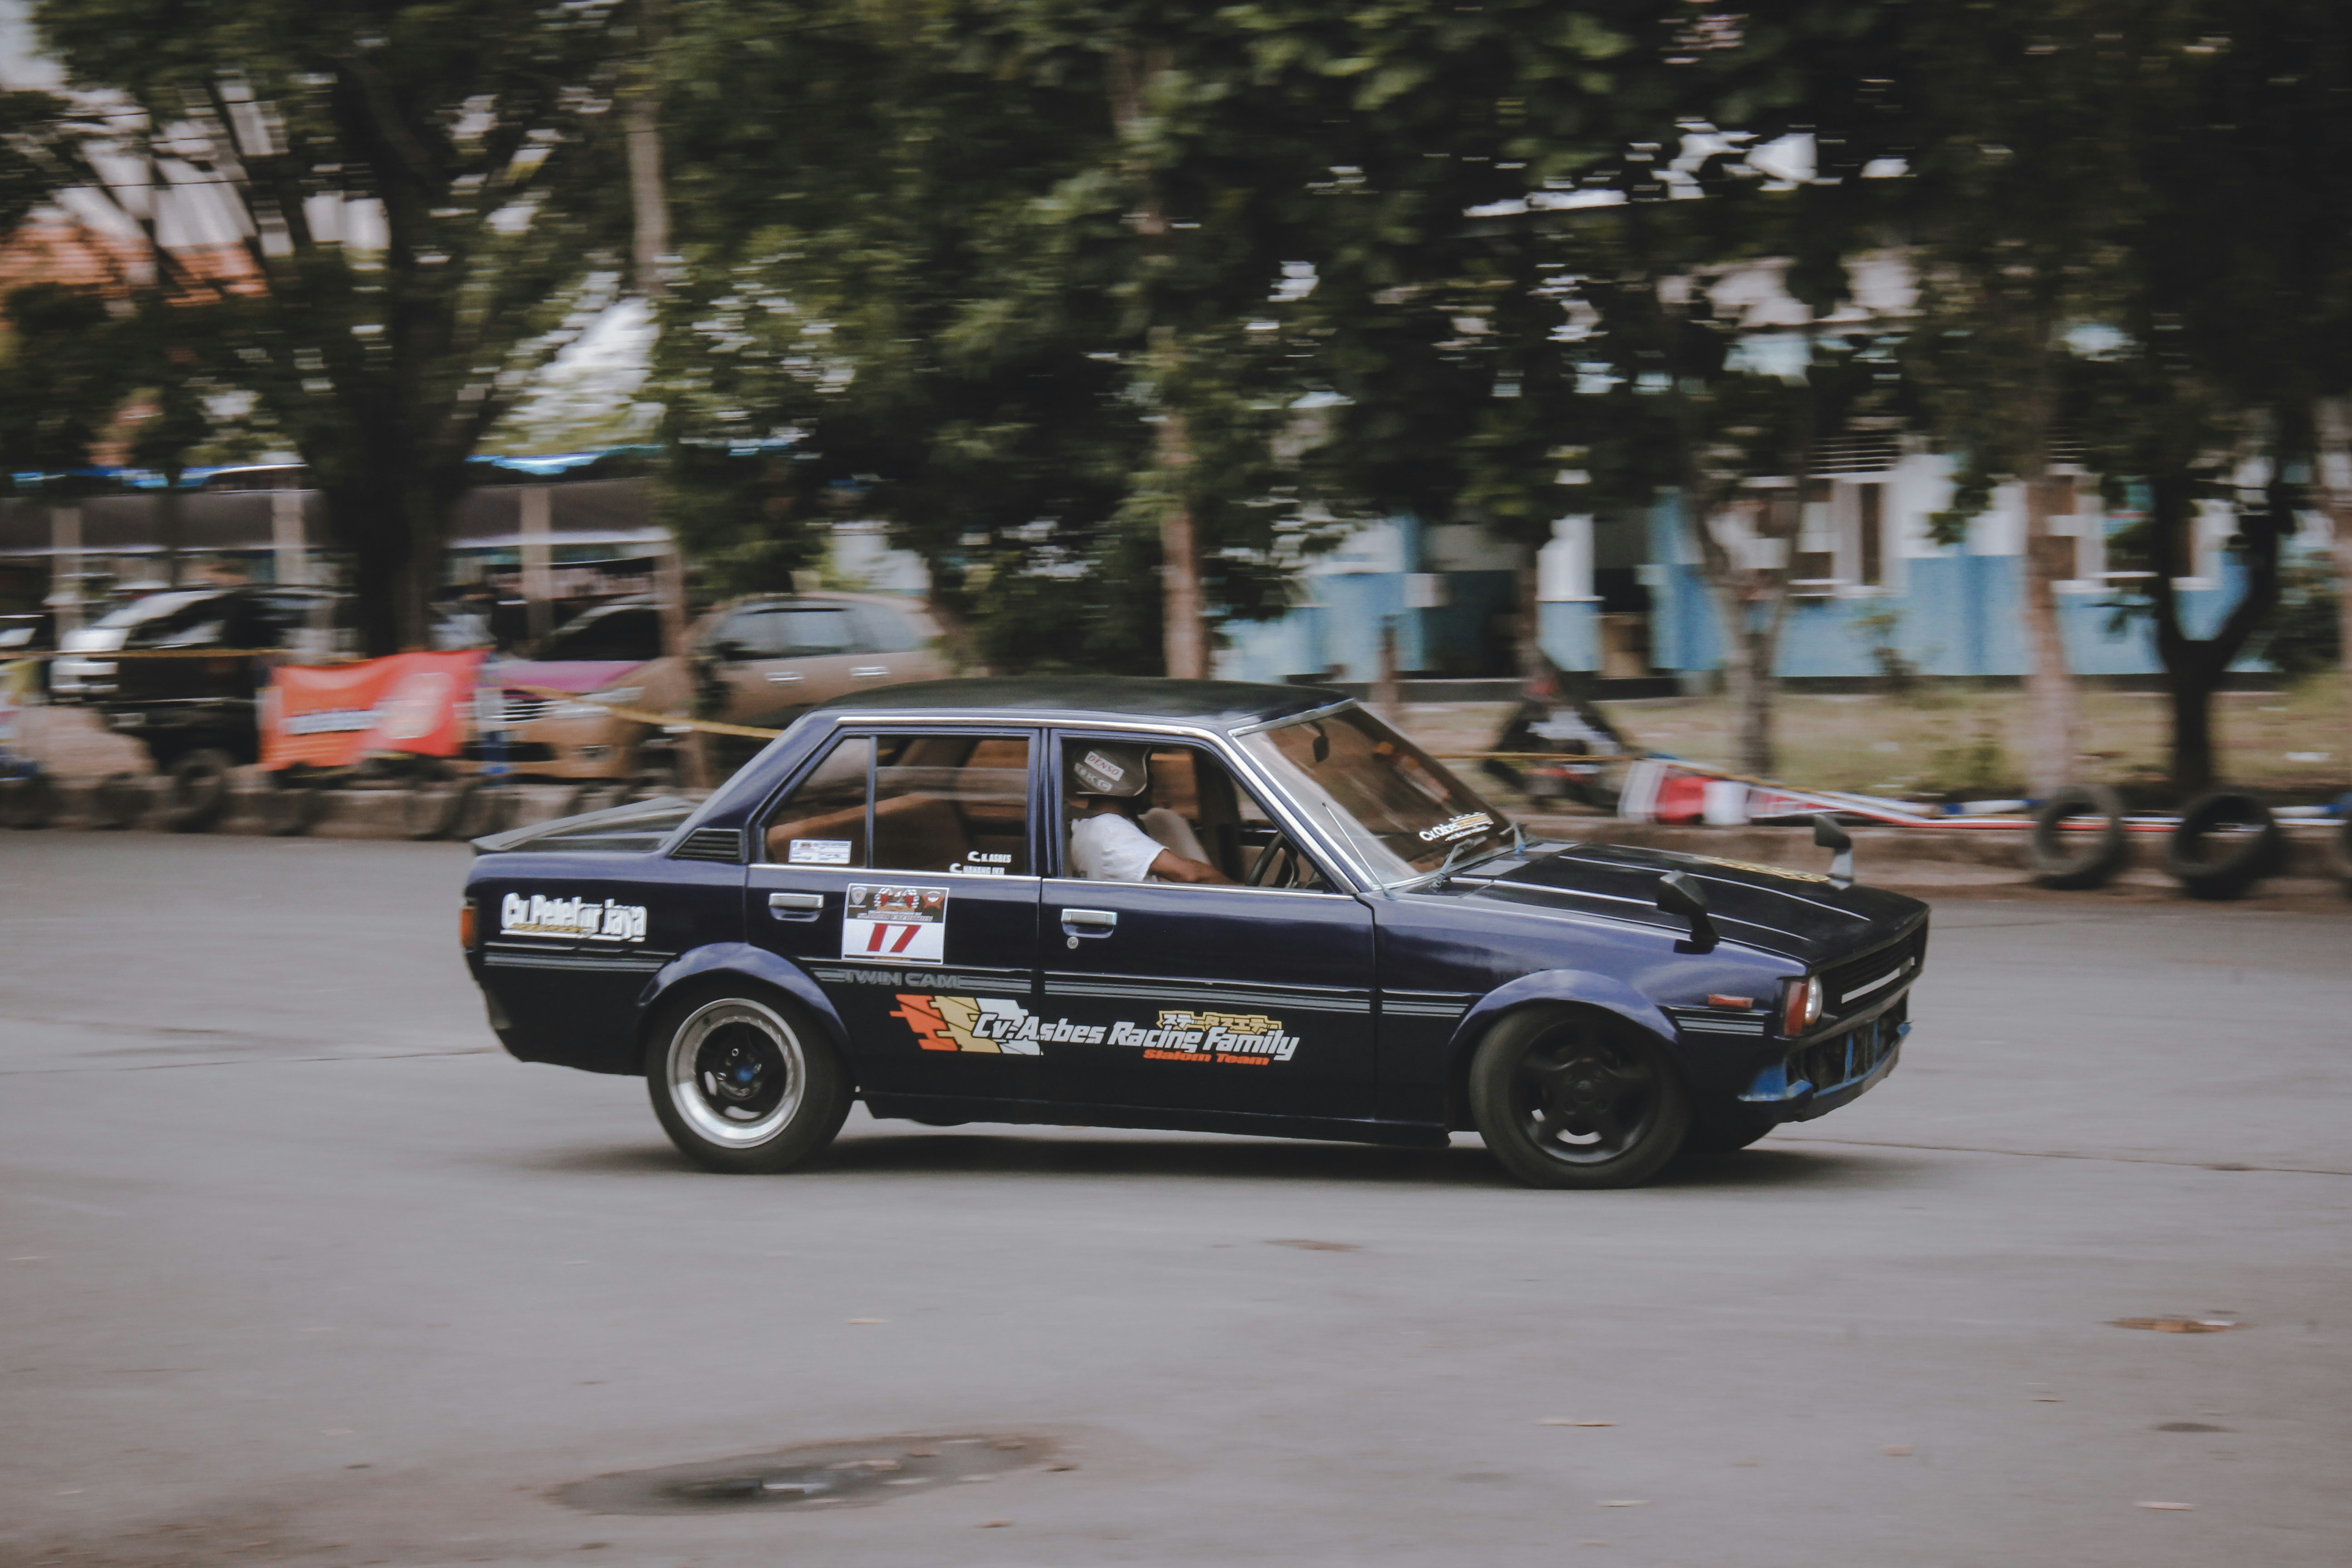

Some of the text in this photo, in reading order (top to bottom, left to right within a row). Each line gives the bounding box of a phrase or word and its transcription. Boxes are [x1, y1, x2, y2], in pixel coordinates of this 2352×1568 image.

[1088, 754, 1120, 776] DENSO
[866, 922, 921, 952] 17
[843, 969, 958, 989] TWIN CAM
[1107, 1021, 1204, 1053] Racing
[1202, 1026, 1299, 1061] Family
[1142, 1049, 1270, 1065] Slalom Team
